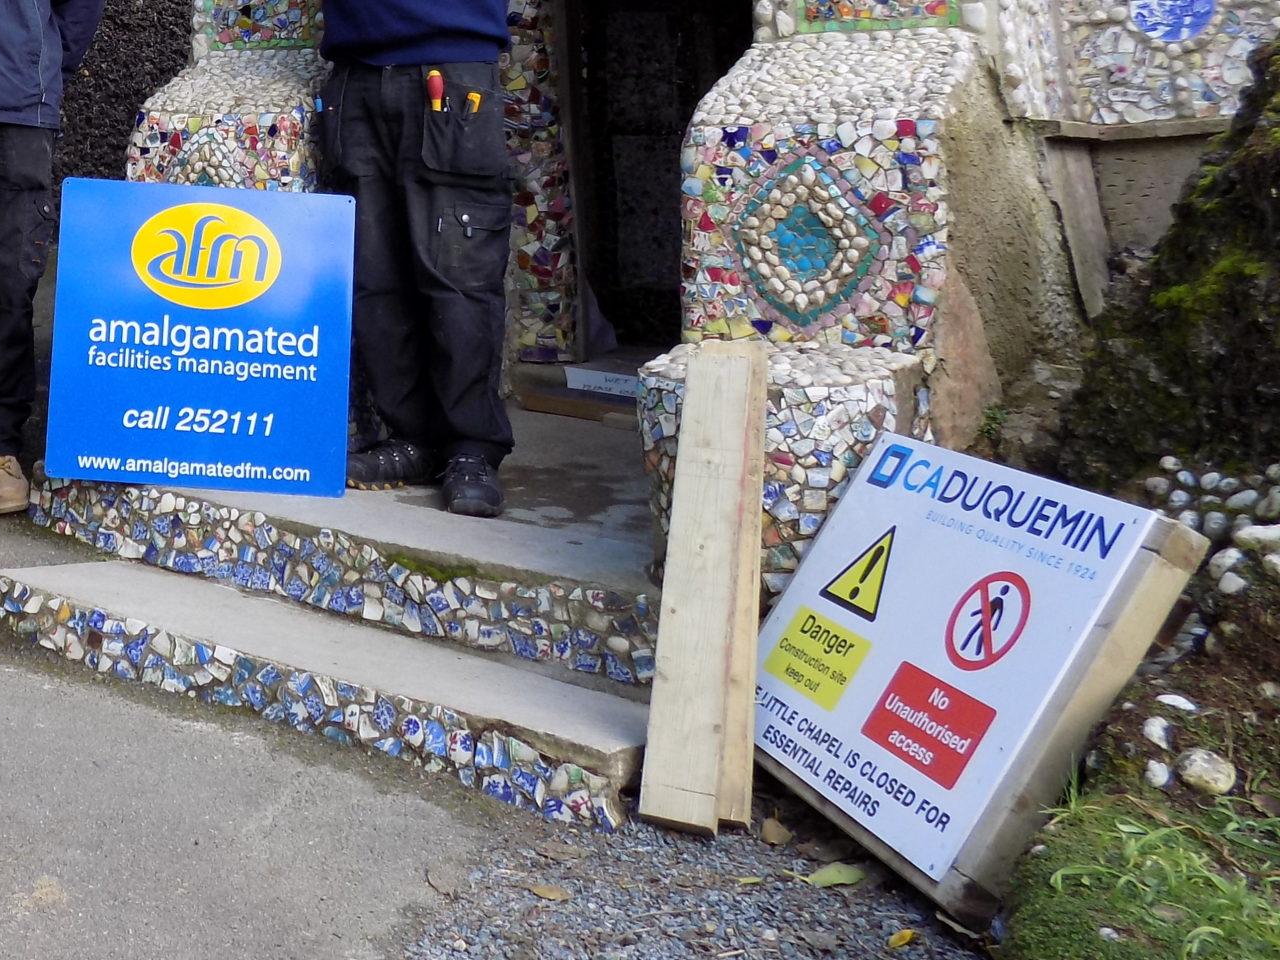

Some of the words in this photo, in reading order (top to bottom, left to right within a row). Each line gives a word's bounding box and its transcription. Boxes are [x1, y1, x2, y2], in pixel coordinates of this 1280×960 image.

[147, 215, 268, 289] afm
[88, 314, 319, 357] amalgamated
[87, 346, 171, 371] facilities
[177, 355, 317, 382] management
[122, 406, 169, 430] call
[175, 406, 274, 437] 252111
[77, 453, 310, 482] www.amalgamatedfm.com
[925, 509, 974, 535] BUILDING
[976, 528, 1025, 554] QUALITY
[1026, 547, 1062, 569] SINCE
[1069, 561, 1098, 581] 1924
[799, 614, 855, 657] Danger
[779, 637, 830, 676] Construction
[830, 669, 847, 686] site
[784, 663, 805, 685] keep
[804, 678, 821, 693] out
[928, 687, 950, 710] No
[884, 692, 972, 754] Unauthorised
[760, 692, 799, 726] LITTLE
[796, 717, 844, 760] CHAPEL
[843, 748, 861, 769] IS
[859, 760, 916, 808] CLOSED
[914, 798, 951, 833] FOR
[888, 730, 934, 765] access
[762, 724, 826, 778] ESSENTIAL
[823, 768, 880, 817] REPAIRS
